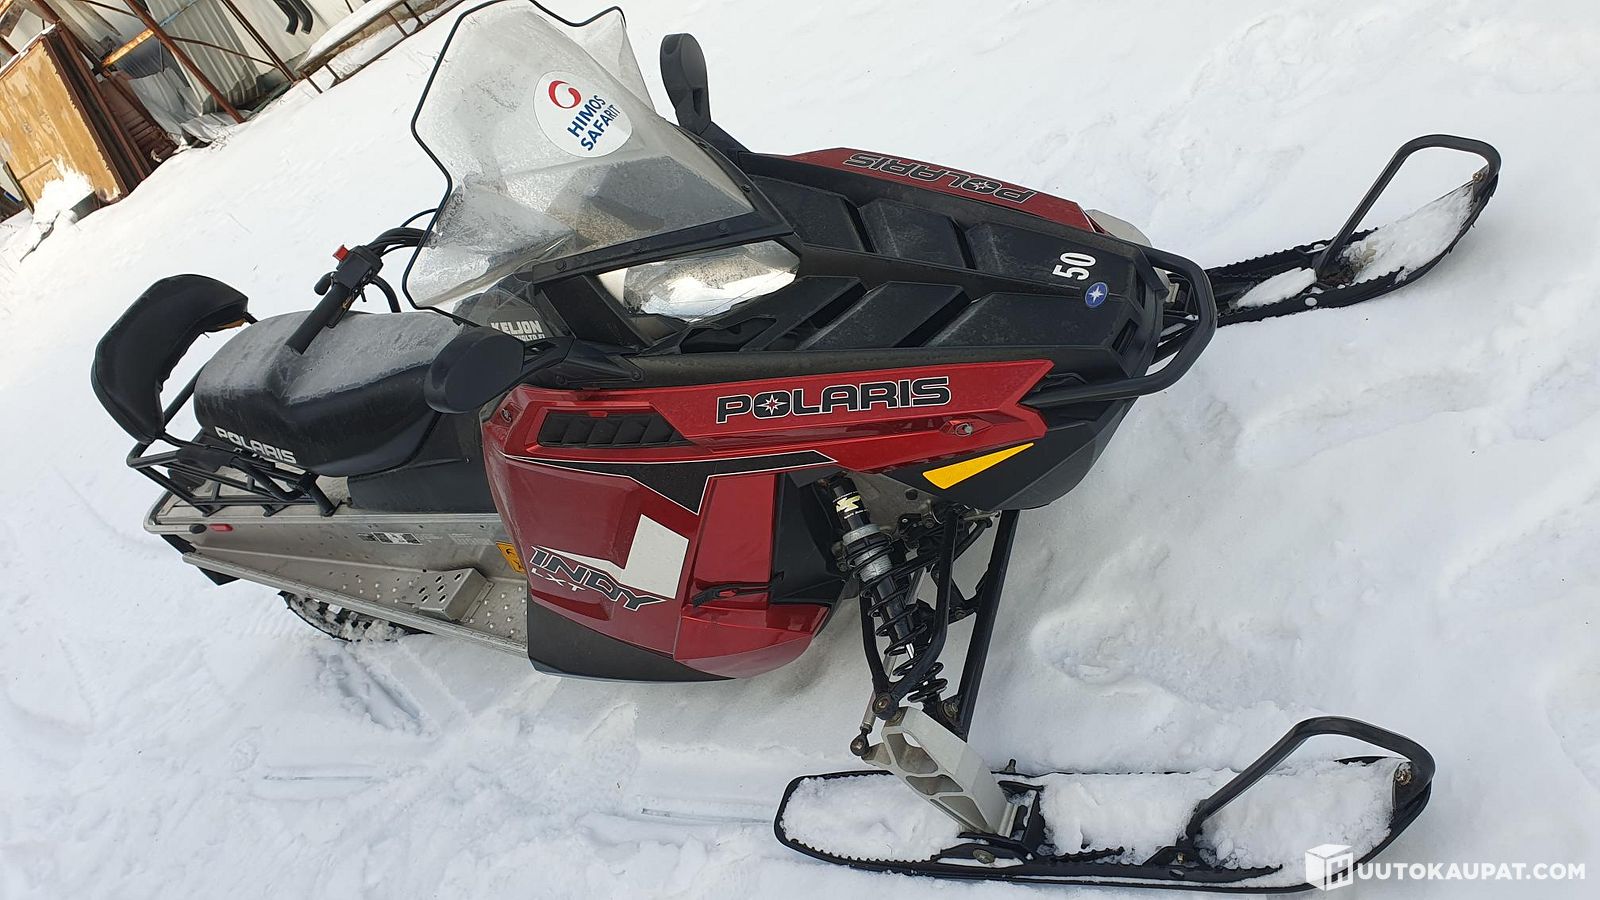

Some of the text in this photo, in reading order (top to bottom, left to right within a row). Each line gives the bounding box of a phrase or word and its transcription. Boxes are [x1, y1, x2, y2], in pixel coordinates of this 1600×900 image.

[567, 94, 606, 138] HIMOS
[580, 104, 621, 151] SAFARIT
[842, 153, 1037, 203] POLARIS
[1052, 252, 1096, 280] 50
[715, 376, 951, 424] POLARIS
[214, 426, 297, 464] POLARIS
[529, 545, 668, 611] INDY
[531, 567, 586, 592] LXT
